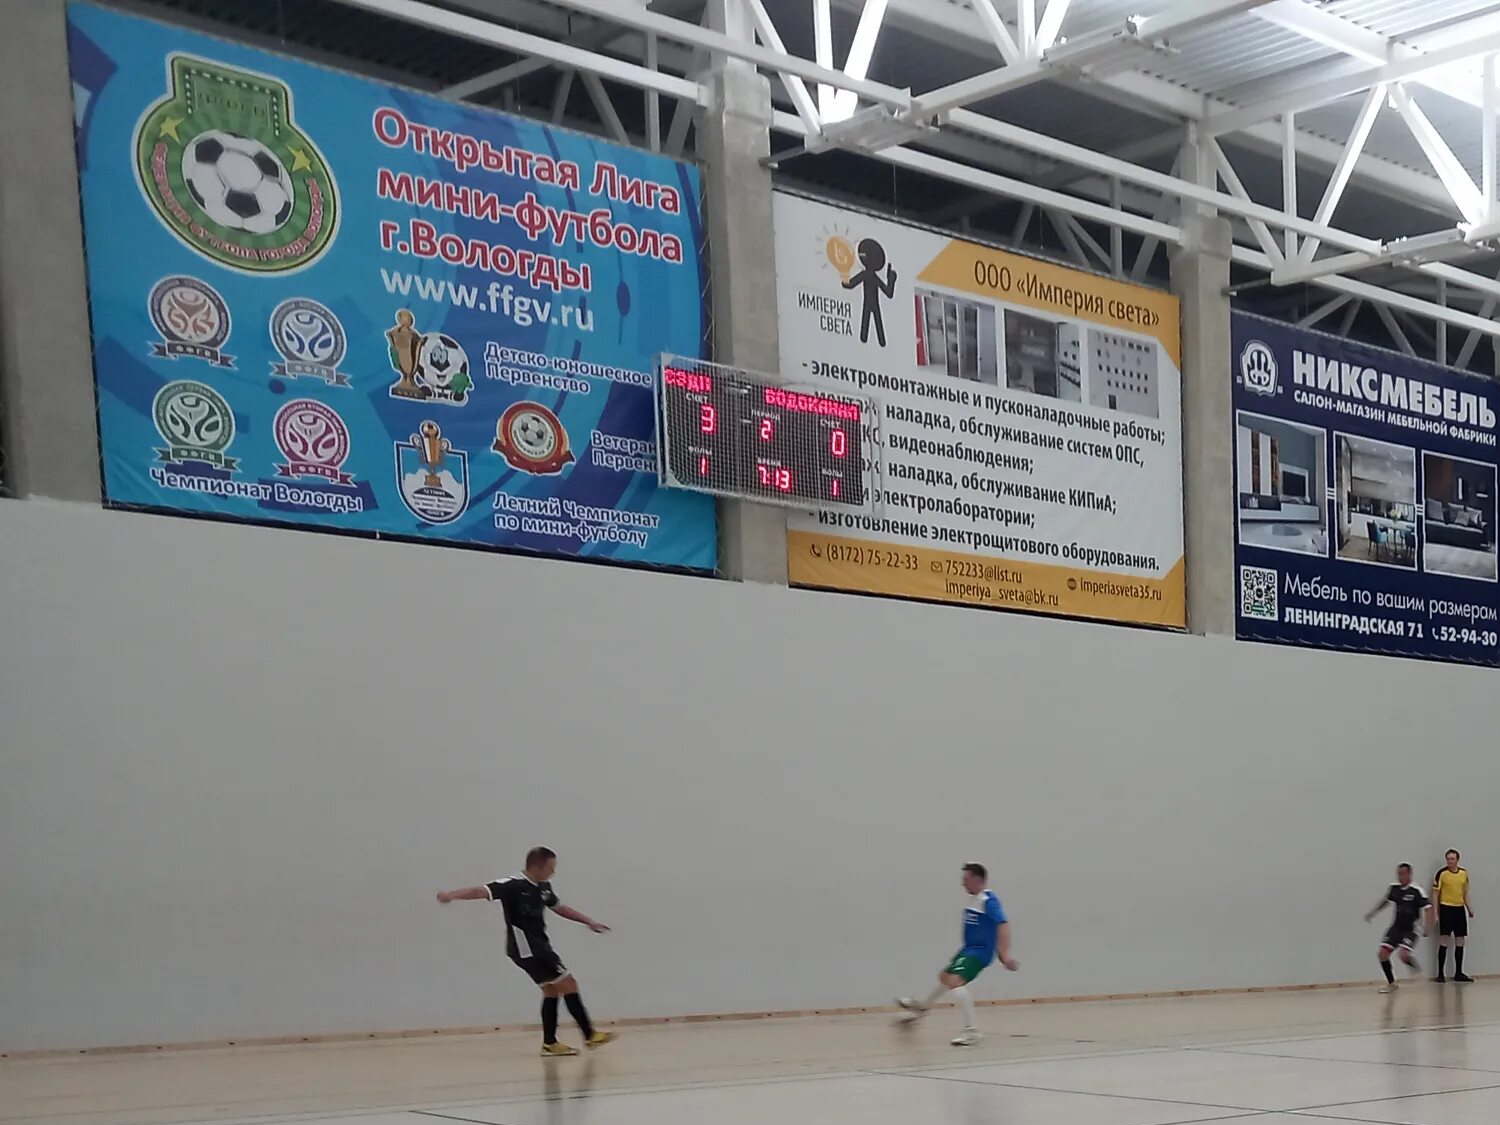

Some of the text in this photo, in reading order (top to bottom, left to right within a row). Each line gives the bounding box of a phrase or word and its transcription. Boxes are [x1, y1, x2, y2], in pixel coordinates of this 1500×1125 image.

[373, 107, 680, 214] Открытая Лига
[377, 169, 683, 264] мини-футбола
[381, 219, 591, 291] г.Вологды
[381, 268, 594, 331] www.ffgv.ru
[797, 292, 852, 318] ИМПЕРИЯ
[974, 260, 1159, 327] ООО «Империя света»
[820, 314, 853, 337] СВЕТА
[484, 341, 651, 386] Детско-юношеское
[486, 361, 590, 394] Первенство
[811, 359, 970, 406] электромонтажные
[972, 394, 982, 406] и
[985, 396, 1110, 433] пусконаладочные
[1113, 419, 1166, 446] работы;
[1293, 350, 1496, 429] НИКСМЕБЕЛЬ
[702, 405, 714, 431] 3
[761, 420, 771, 440] 2
[886, 404, 1145, 469] наладка, обслуживание систем ОПС,
[1294, 389, 1496, 446] САЛОН-МАГАЗИН МЕБЕЛЬНОЙ ФАБРИКИ
[591, 429, 658, 456] Ветеран
[592, 448, 658, 472] Первен
[832, 430, 845, 456] 0
[889, 434, 1034, 474] видеонаблюдения;
[151, 468, 363, 513] Чемпионат Вологды
[875, 489, 1035, 529] электролаборатории;
[888, 463, 958, 490] наладка,
[961, 472, 1066, 505] обслуживание
[1069, 484, 1116, 516] КИПиА;
[493, 492, 660, 528] Летний Чемпионат
[495, 513, 647, 548] по мини-футболу
[819, 510, 1160, 572] изготовление электрощитового оборудования.
[826, 542, 918, 571] (8172) 75-22-33
[946, 559, 1022, 585] 752233@list.ru
[945, 580, 1059, 607] imperiya_sveta@bk.ru
[1080, 578, 1162, 602] imperiasveta35.ru
[1284, 572, 1498, 624] Мебель по вашим размерам
[1284, 607, 1497, 646] ЛЕНИНГРАДСКАЯ 71 52-94-30
